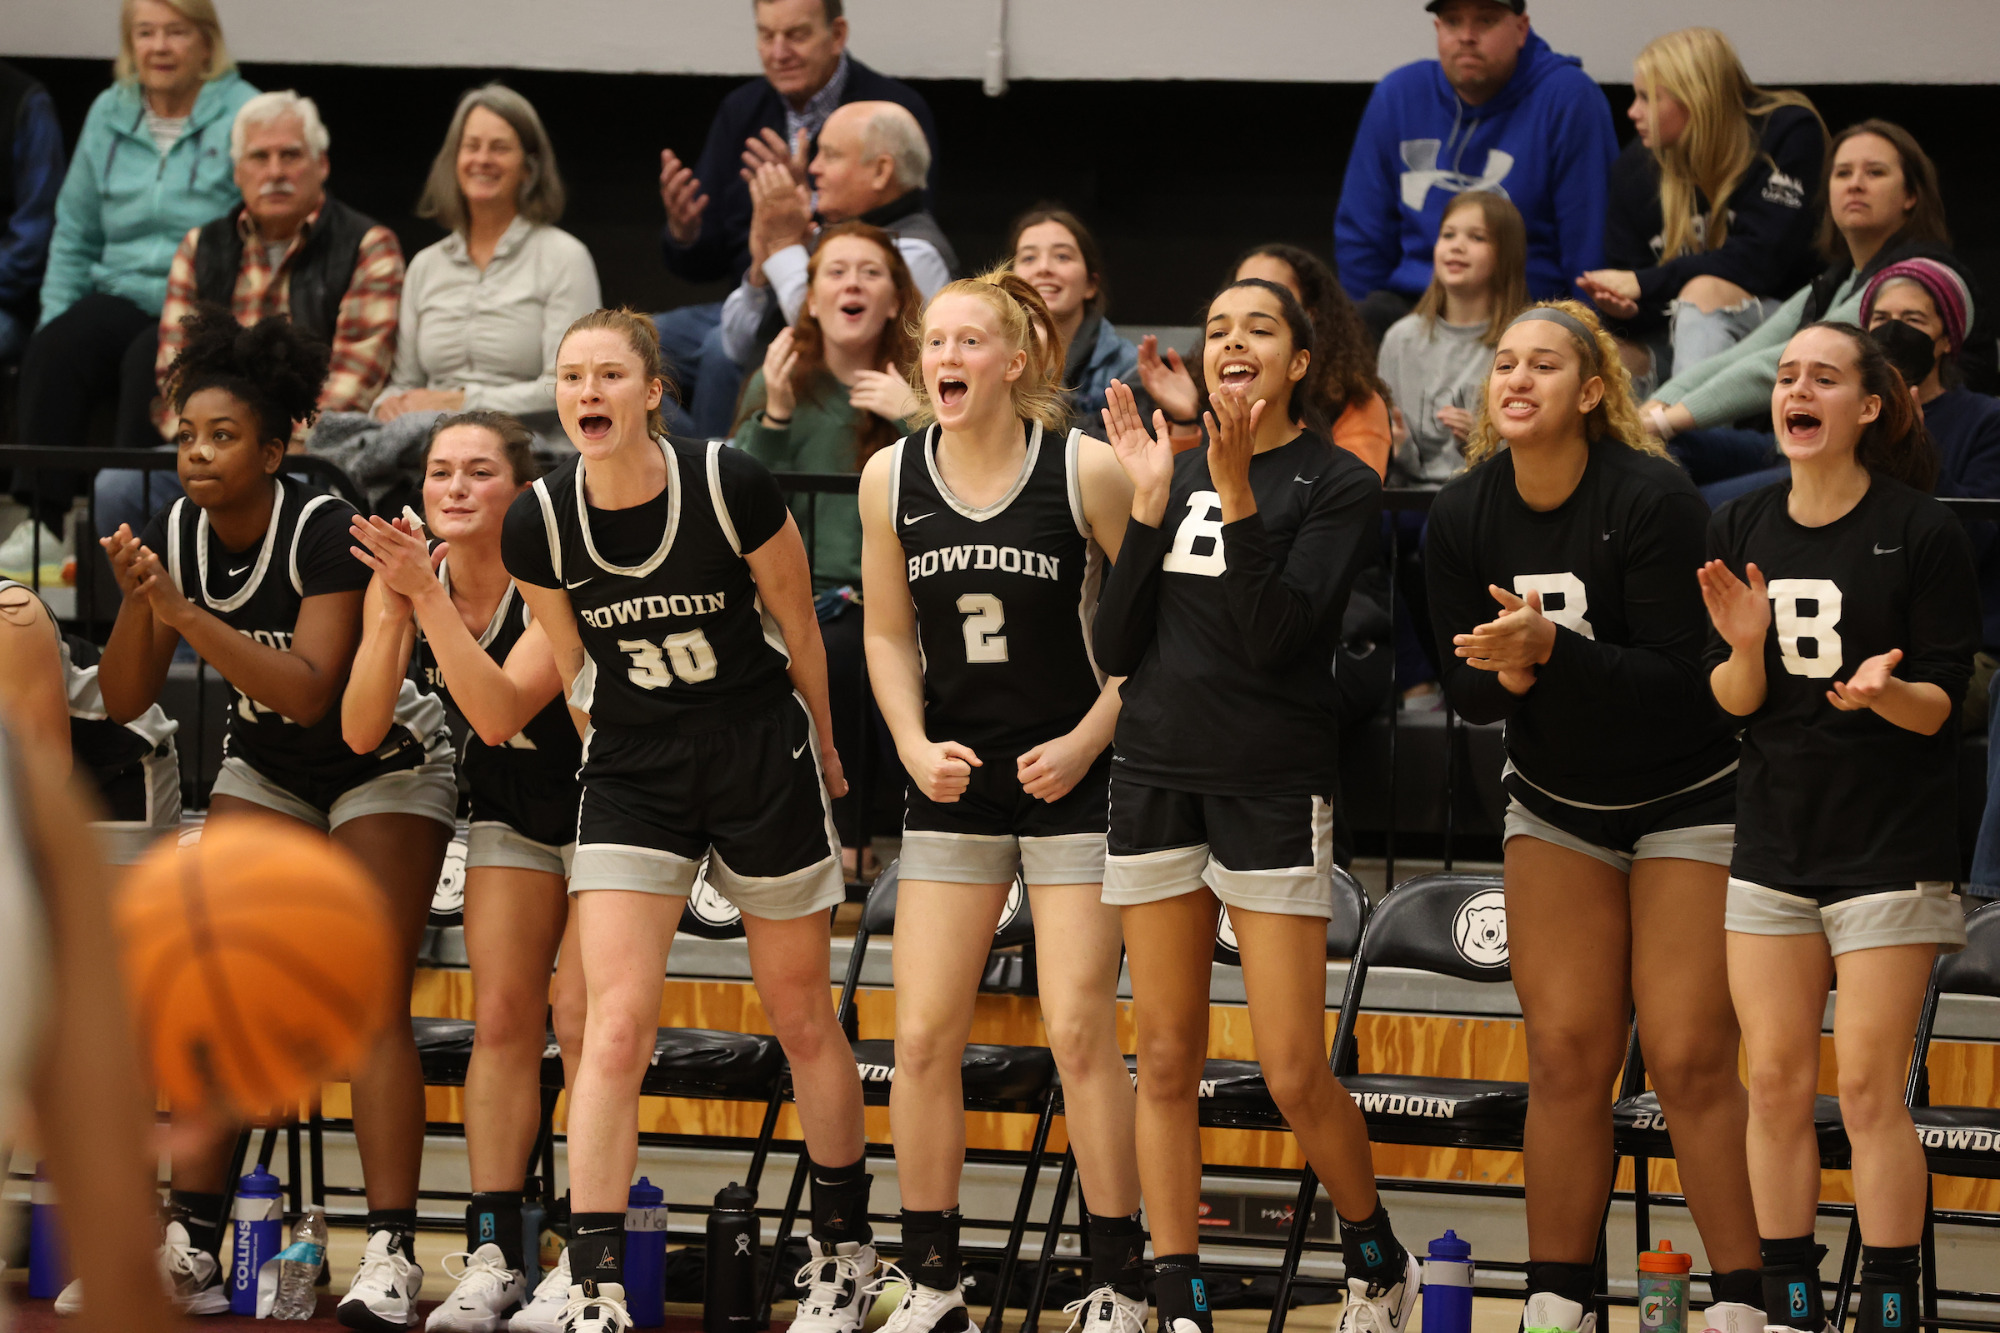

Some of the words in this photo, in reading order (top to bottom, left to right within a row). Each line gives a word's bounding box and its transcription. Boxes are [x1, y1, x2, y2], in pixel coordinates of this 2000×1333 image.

[908, 544, 1060, 582] BOWDOIN
[580, 591, 726, 629] BOWDOIN
[955, 592, 1009, 664] 2
[1767, 578, 1843, 678] B
[617, 627, 718, 691] 30
[1350, 1092, 1458, 1119] WDOIN
[236, 1221, 251, 1291] COLLINS
